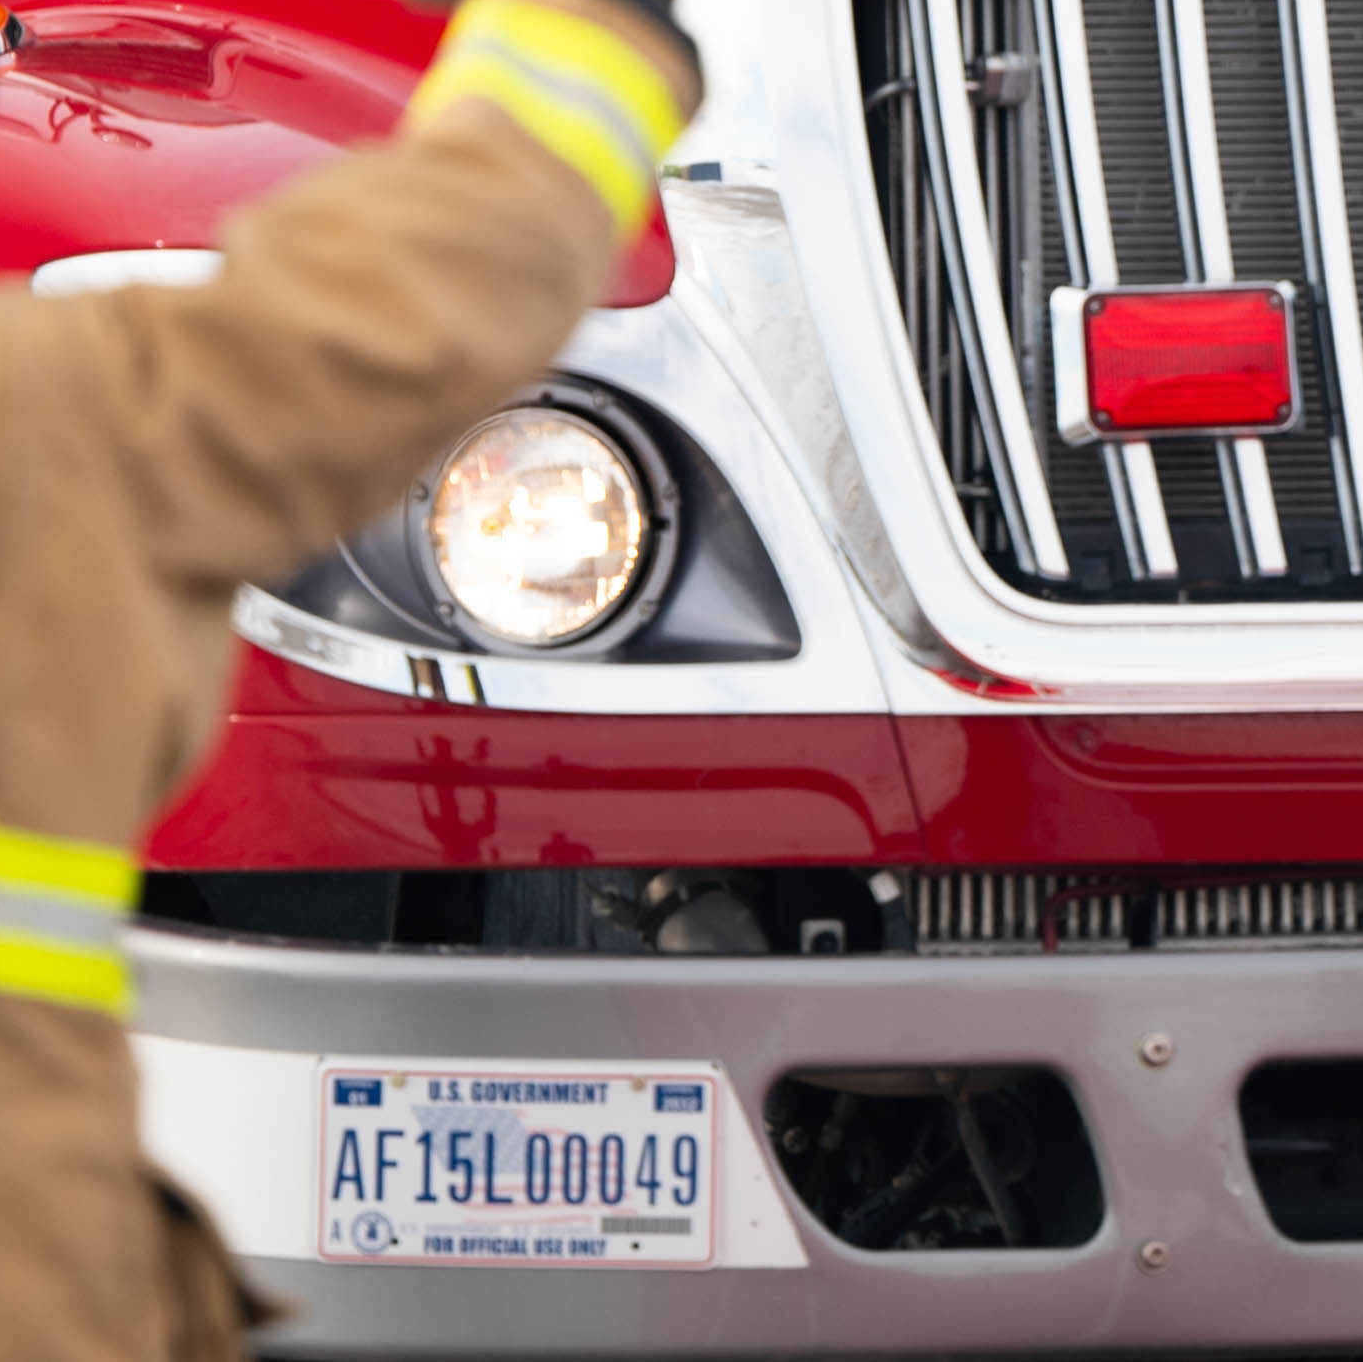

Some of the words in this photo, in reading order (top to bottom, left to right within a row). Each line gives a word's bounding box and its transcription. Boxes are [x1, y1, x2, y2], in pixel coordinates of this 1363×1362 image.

[428, 1080, 463, 1101] U.S.
[471, 1081, 609, 1104] GOVERNMENT
[331, 1128, 698, 1206] AF15L00049
[424, 1235, 454, 1254] FOR
[459, 1235, 527, 1256] OFFICIAL
[533, 1237, 563, 1256] USE
[568, 1238, 607, 1257] ONLY
